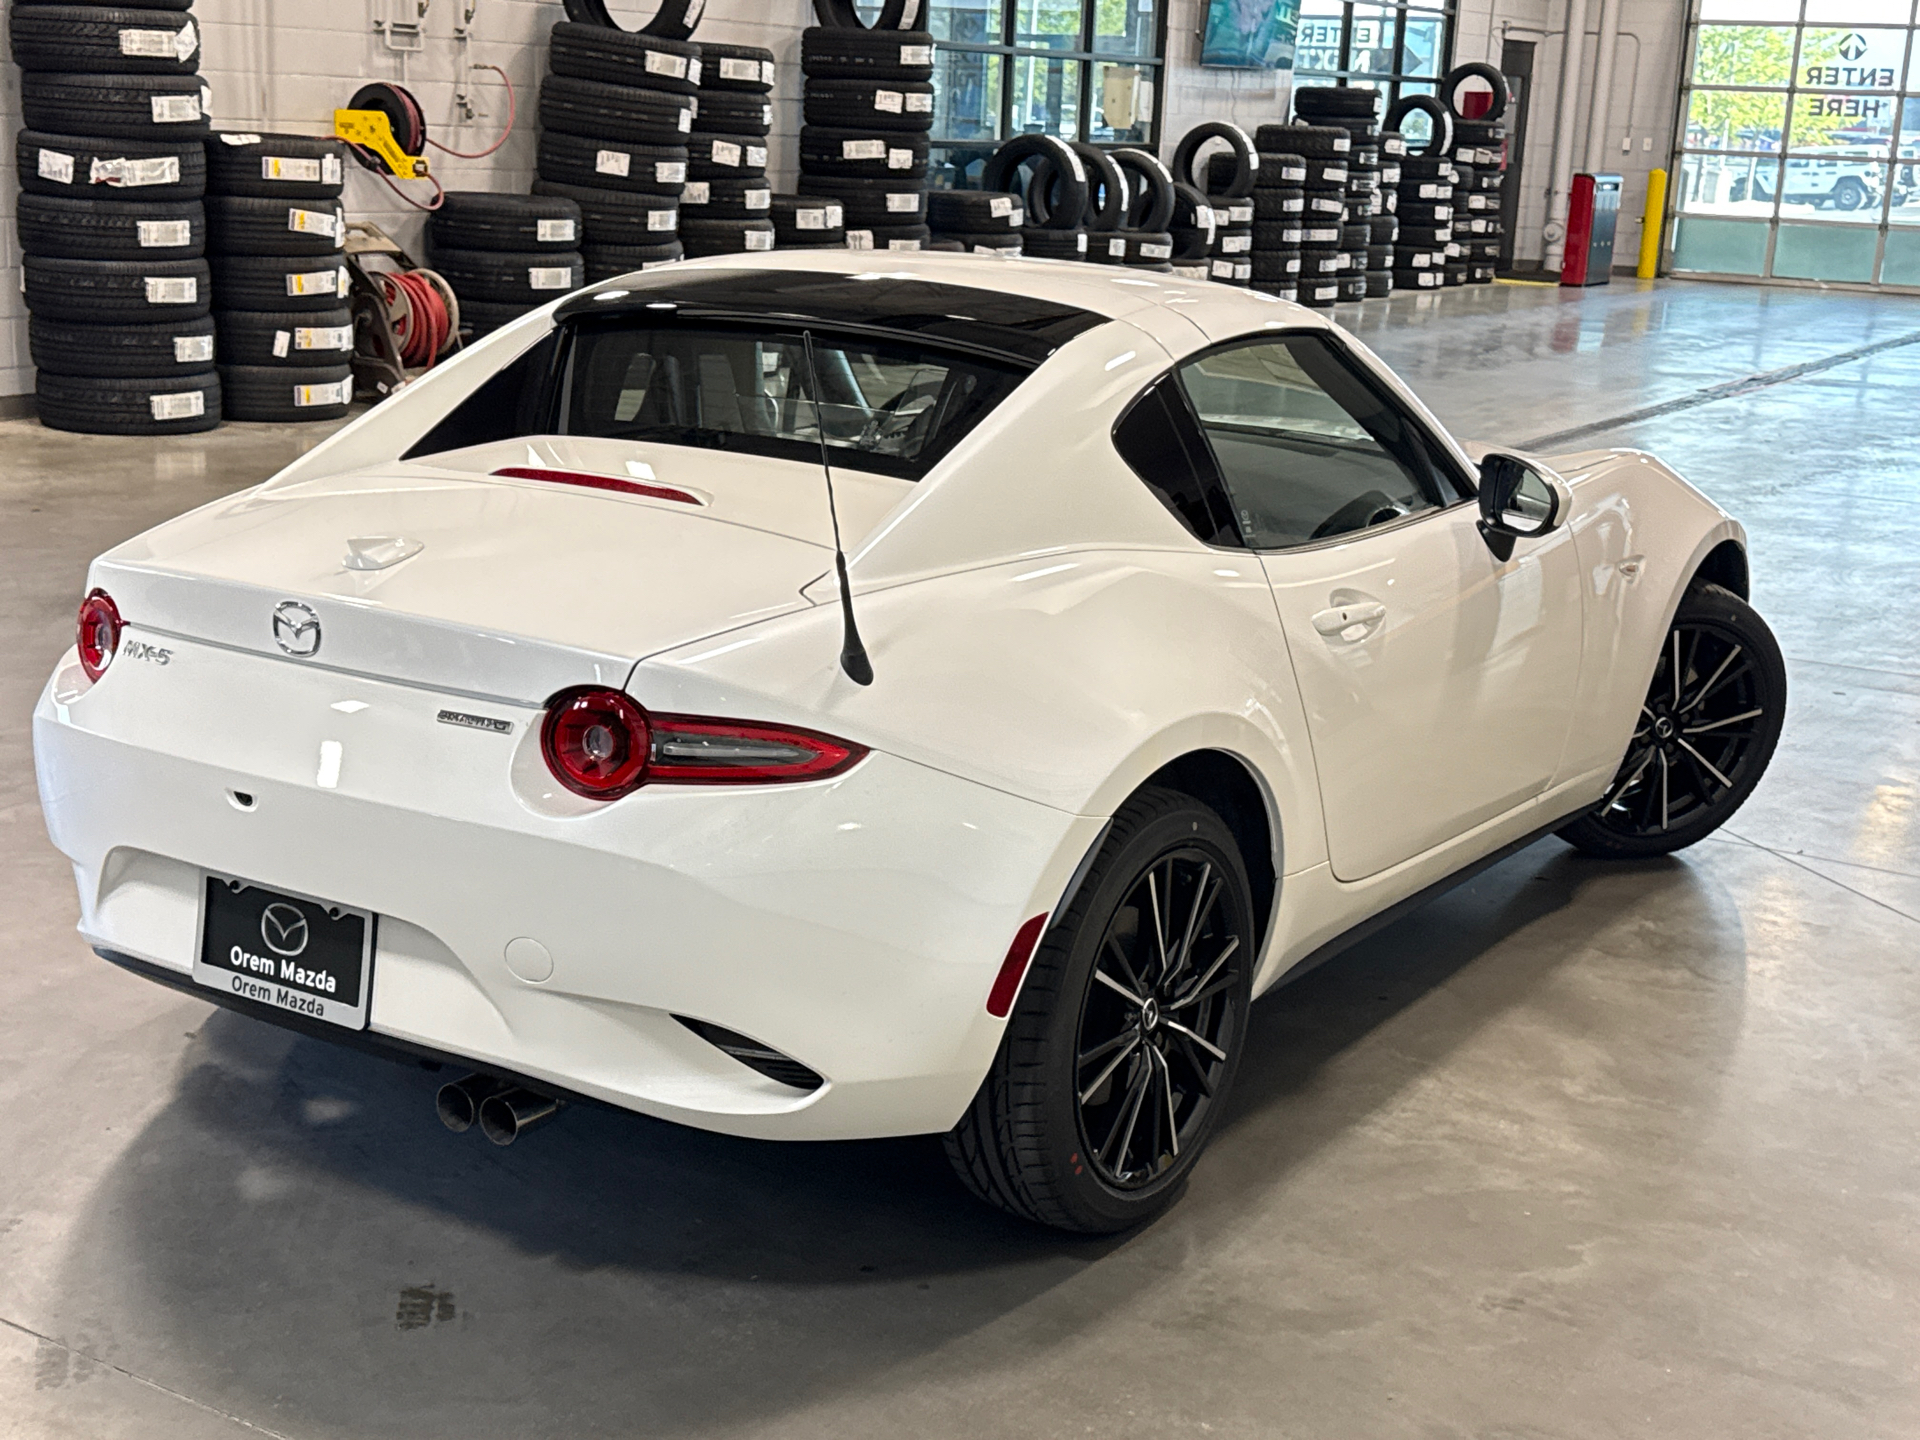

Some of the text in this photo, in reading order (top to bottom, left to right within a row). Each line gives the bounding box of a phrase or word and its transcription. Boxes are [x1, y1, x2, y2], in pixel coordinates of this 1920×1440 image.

[123, 639, 174, 666] MX-5
[230, 945, 337, 993] Orem Mazda
[231, 975, 325, 1017] Orem Mazda
